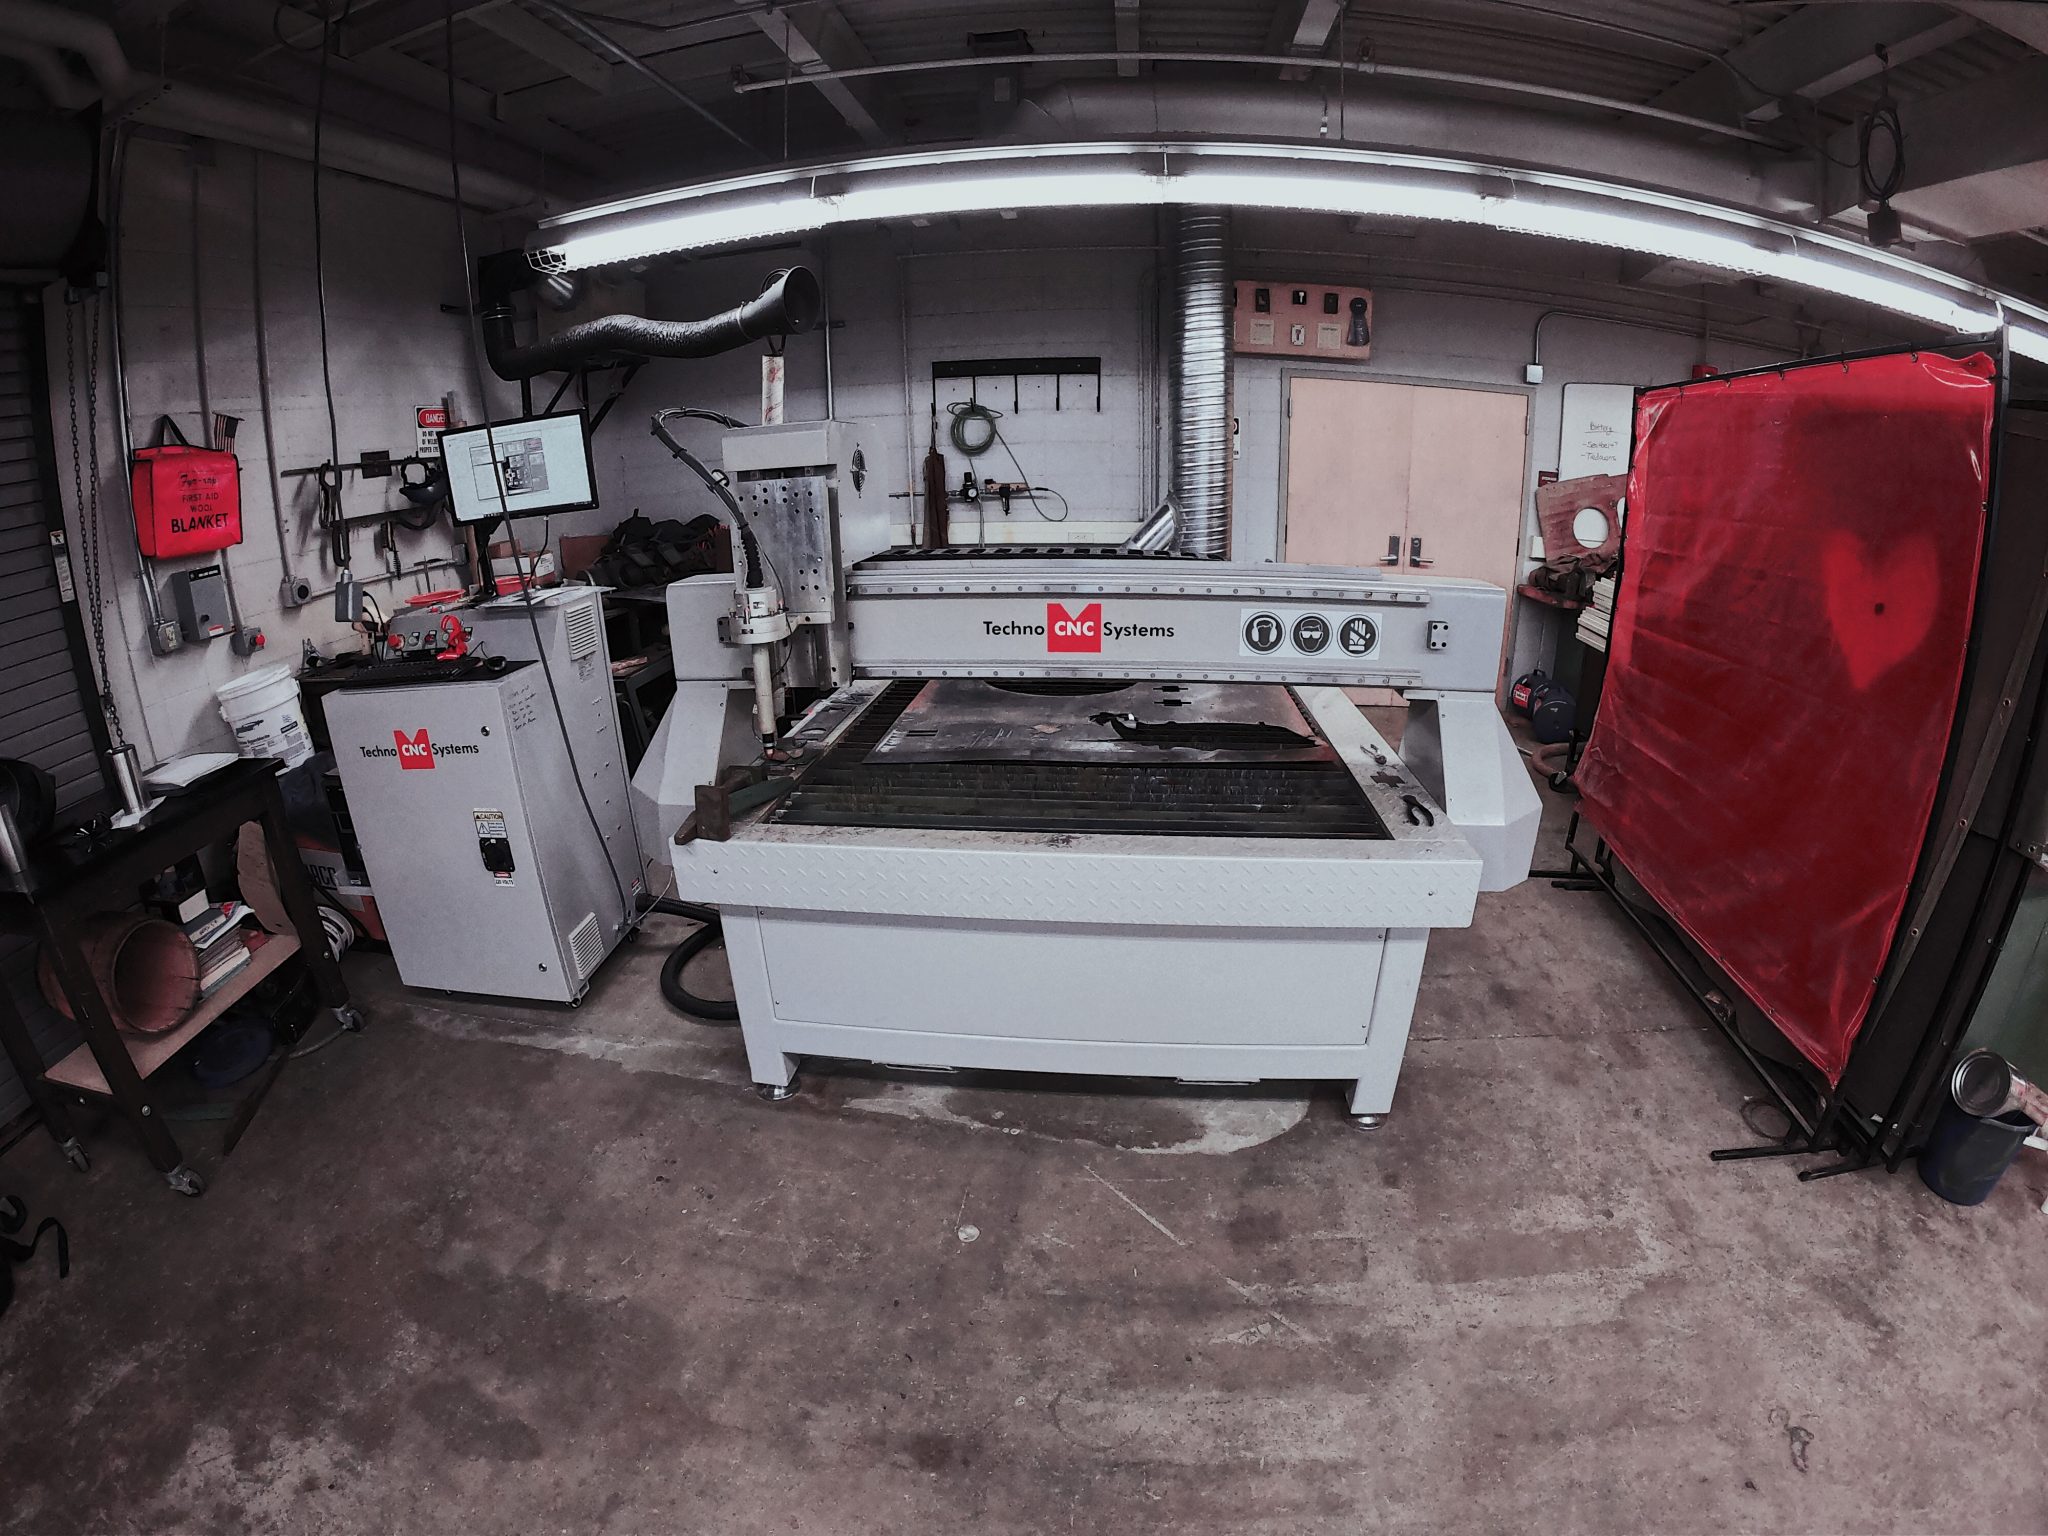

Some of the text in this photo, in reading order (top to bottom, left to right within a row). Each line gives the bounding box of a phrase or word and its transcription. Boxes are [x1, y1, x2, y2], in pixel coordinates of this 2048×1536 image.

[183, 492, 219, 502] FIRST AID
[190, 504, 213, 513] WOOL
[171, 513, 229, 534] BLANKET
[983, 620, 1175, 640] Techno CNC Systems
[360, 743, 479, 758] Techno CNC Systems
